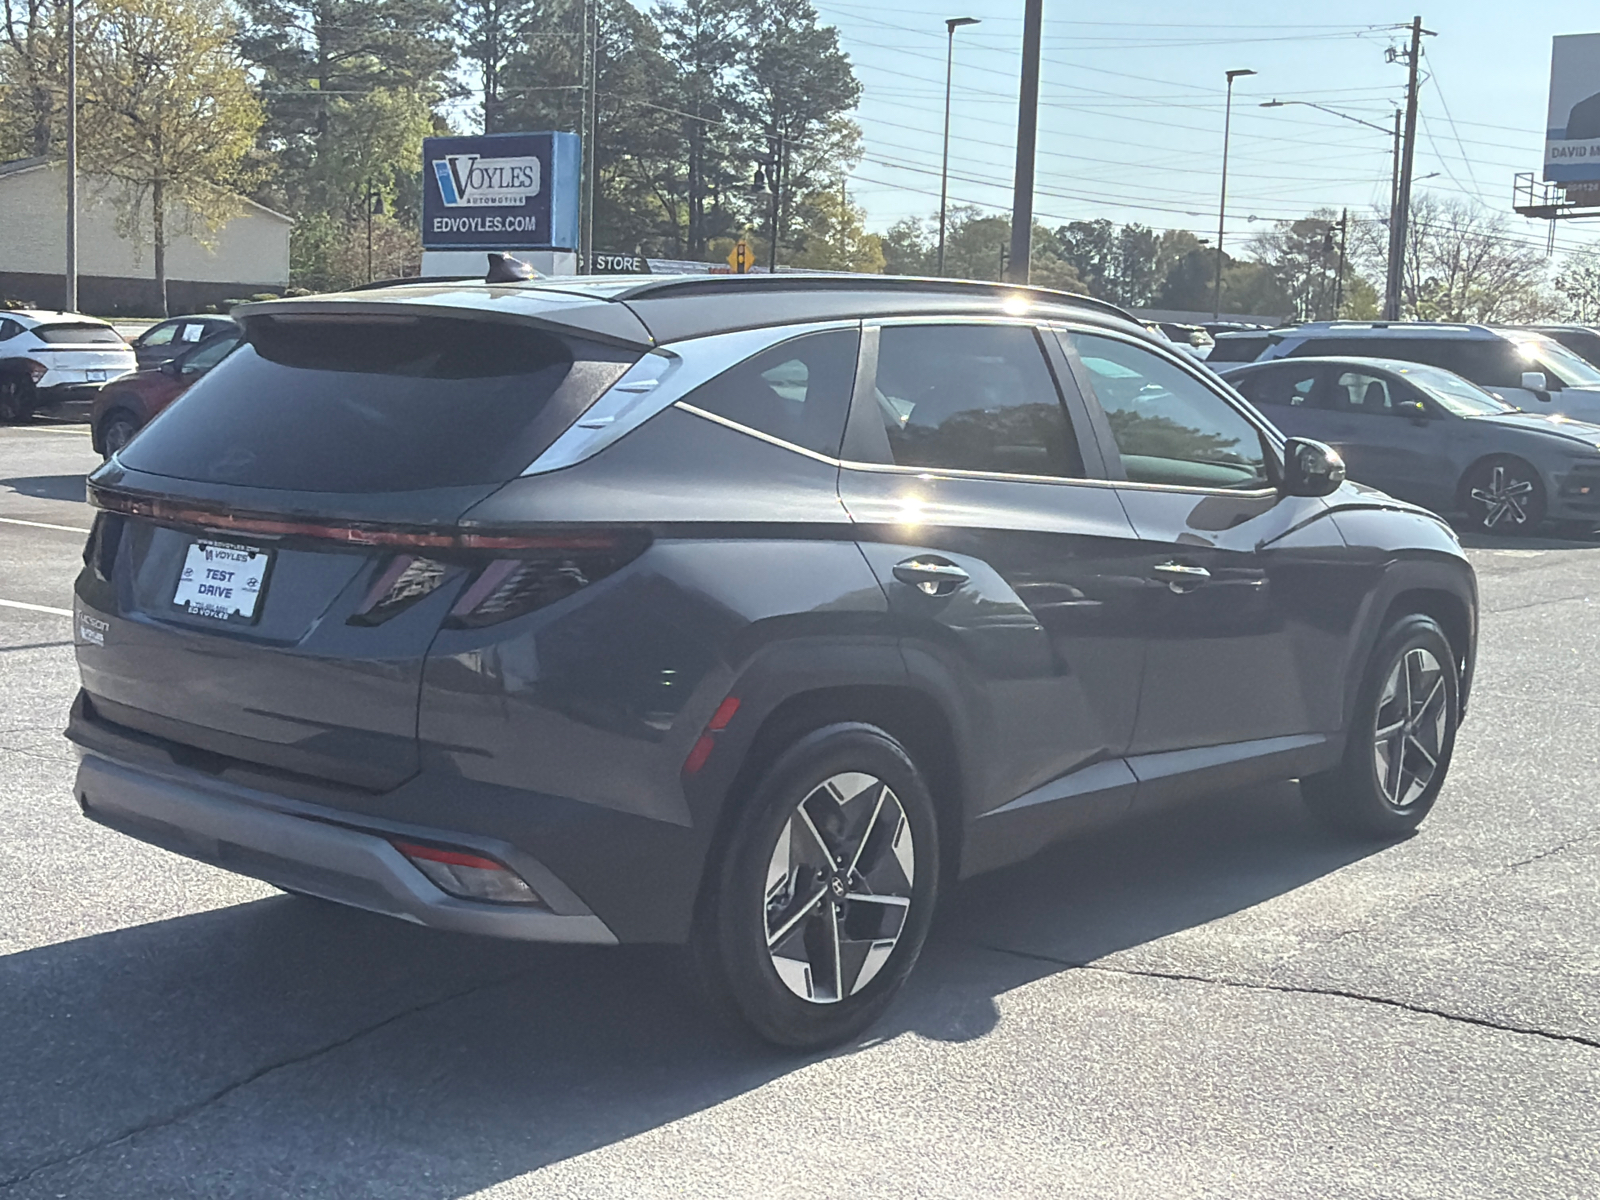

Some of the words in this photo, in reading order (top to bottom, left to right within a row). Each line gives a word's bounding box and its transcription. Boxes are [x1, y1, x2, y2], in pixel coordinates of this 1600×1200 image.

[1551, 146, 1587, 158] DAVID
[447, 157, 533, 200] VOYLES
[466, 196, 524, 205] AUTOMOTIVE
[433, 216, 536, 233] EDVOYLES.COM
[596, 255, 642, 271] STORE
[215, 550, 248, 562] VOYLES
[206, 568, 235, 582] TEST
[198, 583, 233, 599] DRIVE
